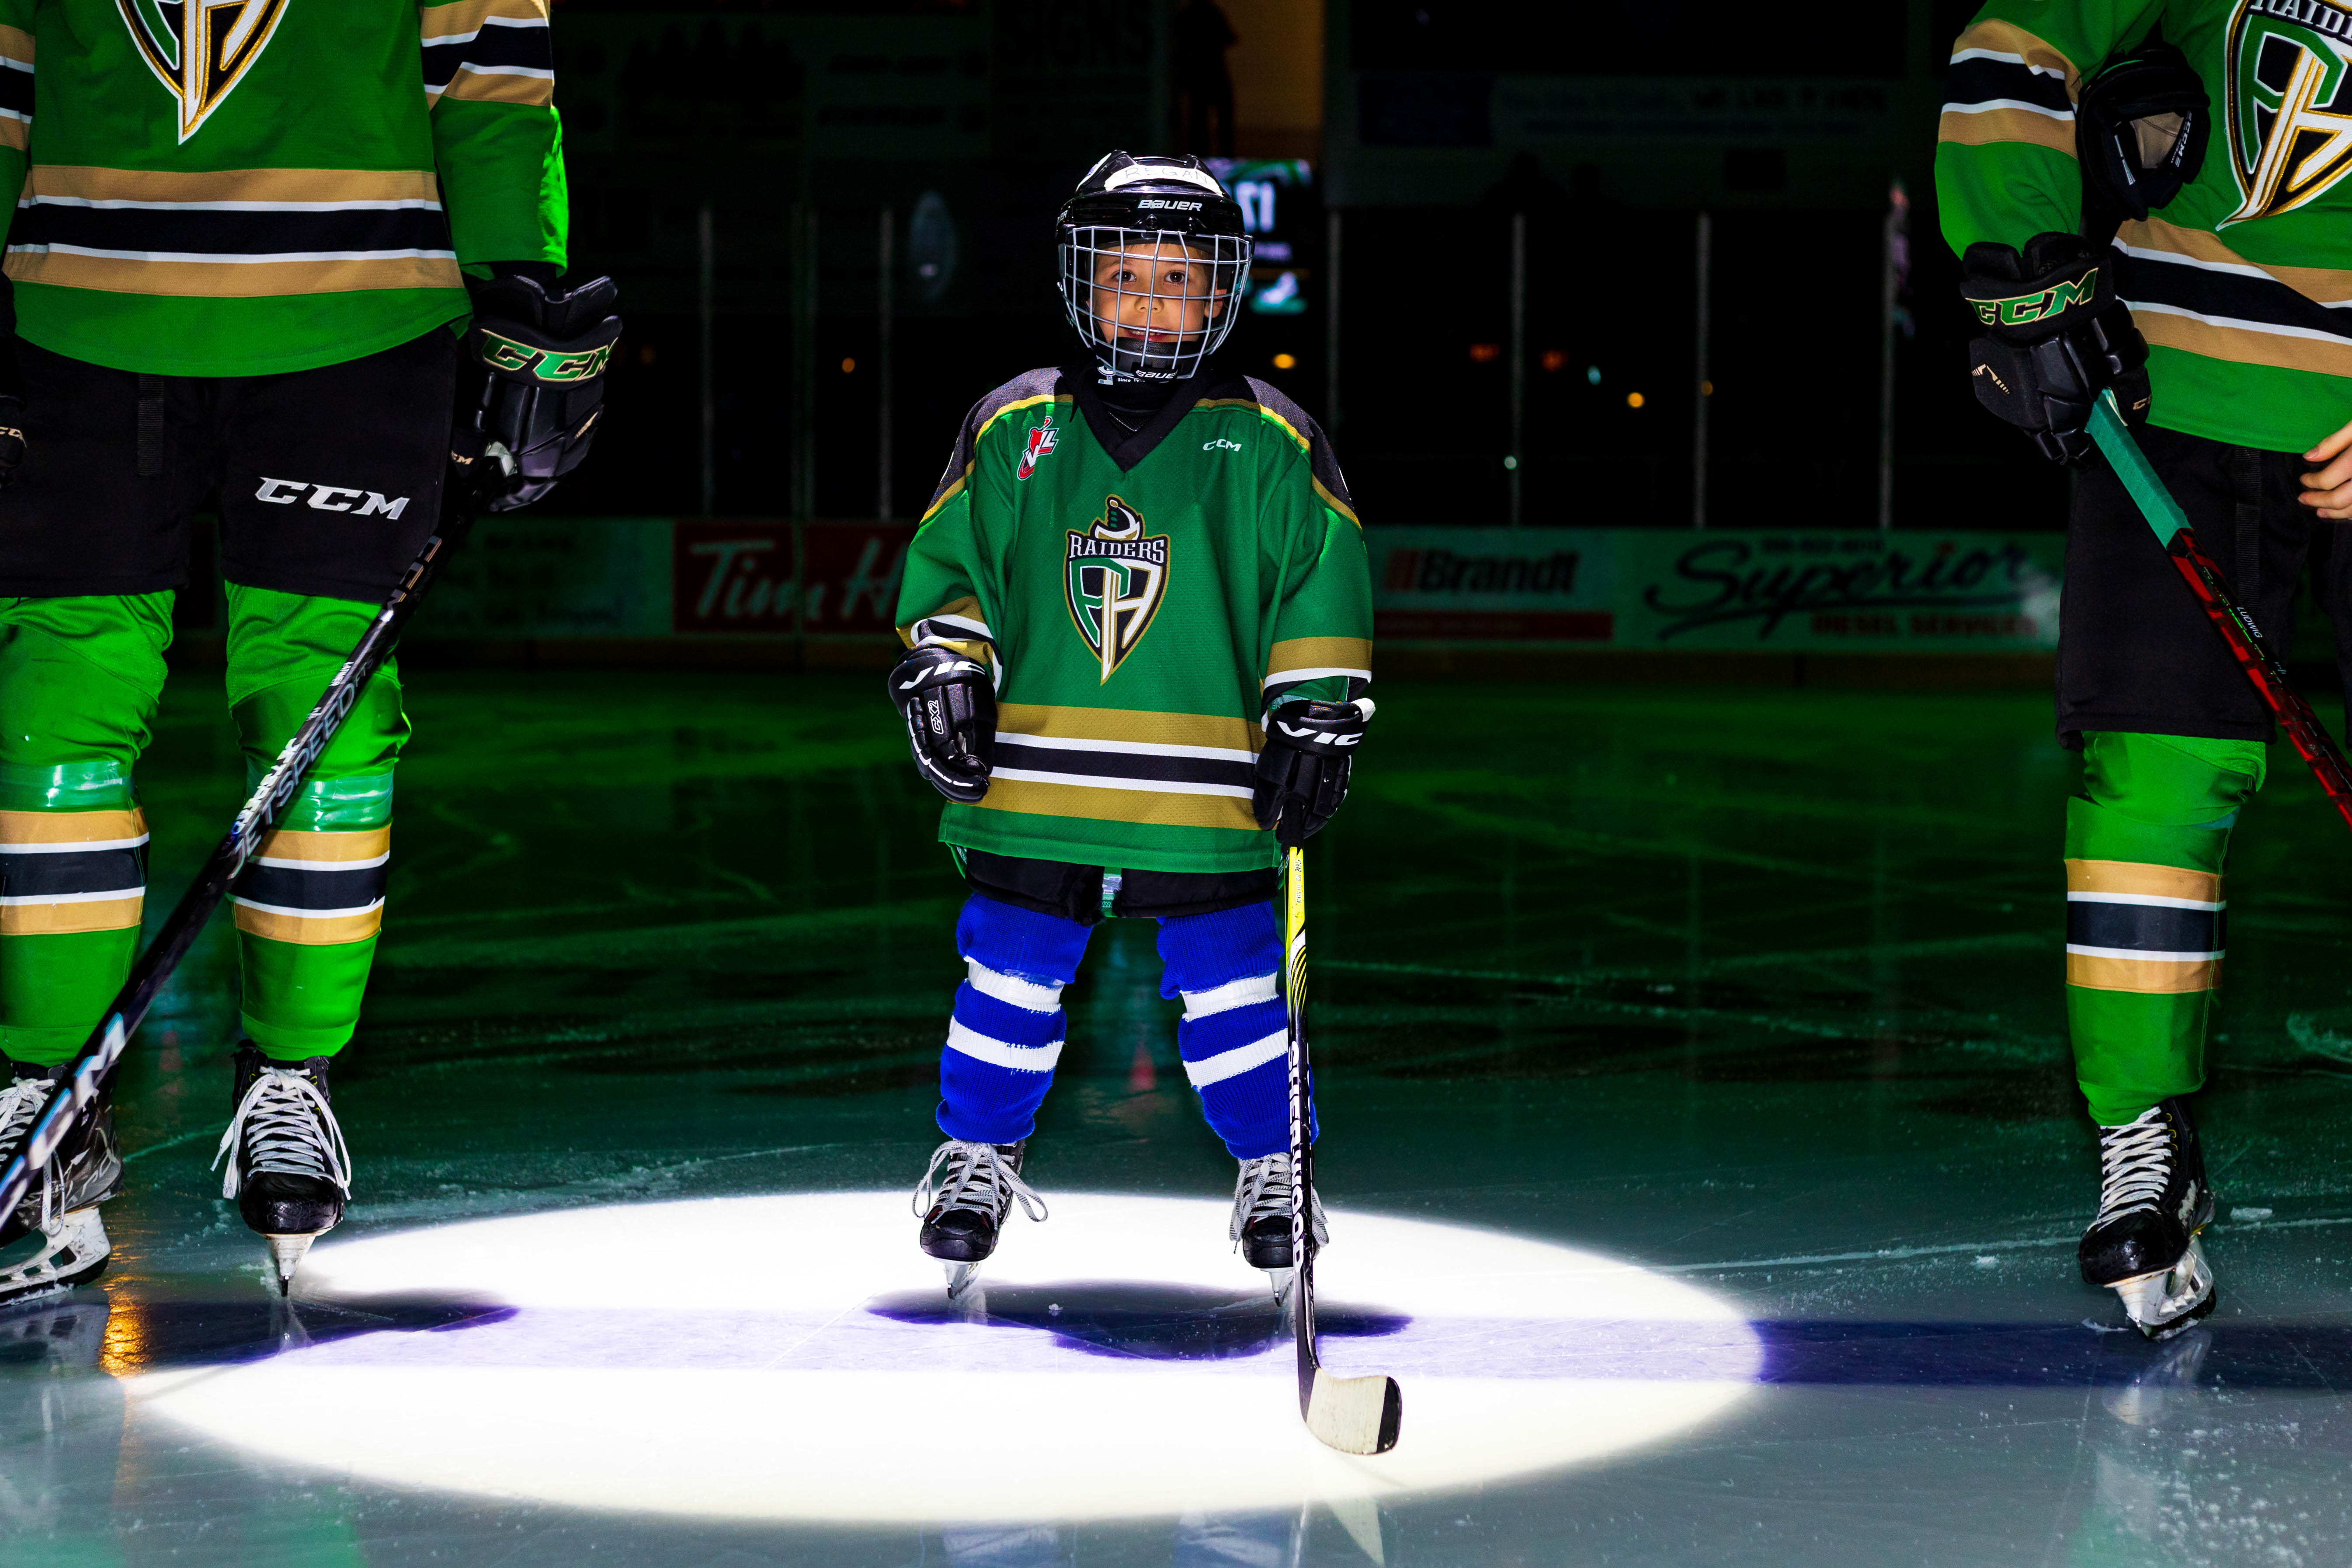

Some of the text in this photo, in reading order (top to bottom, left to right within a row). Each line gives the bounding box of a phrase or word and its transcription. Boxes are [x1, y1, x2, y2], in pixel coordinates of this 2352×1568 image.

[1125, 167, 1208, 184] REGAN
[1137, 199, 1202, 212] BAUER
[1965, 267, 2099, 326] CCM
[481, 329, 618, 382] CCM
[1136, 369, 1178, 379] BAUE
[1203, 438, 1242, 452] CCM
[255, 476, 410, 521] CCM
[1069, 534, 1165, 564] RAIDERS
[688, 533, 910, 622] Tim H
[1419, 549, 1579, 593] Brandt
[1643, 539, 2028, 639] Superior
[2235, 606, 2263, 639] LUDWIG
[899, 661, 985, 689] VIC
[928, 699, 944, 735] CX2
[1277, 720, 1363, 746] VIC
[227, 682, 355, 880] JETSPEED
